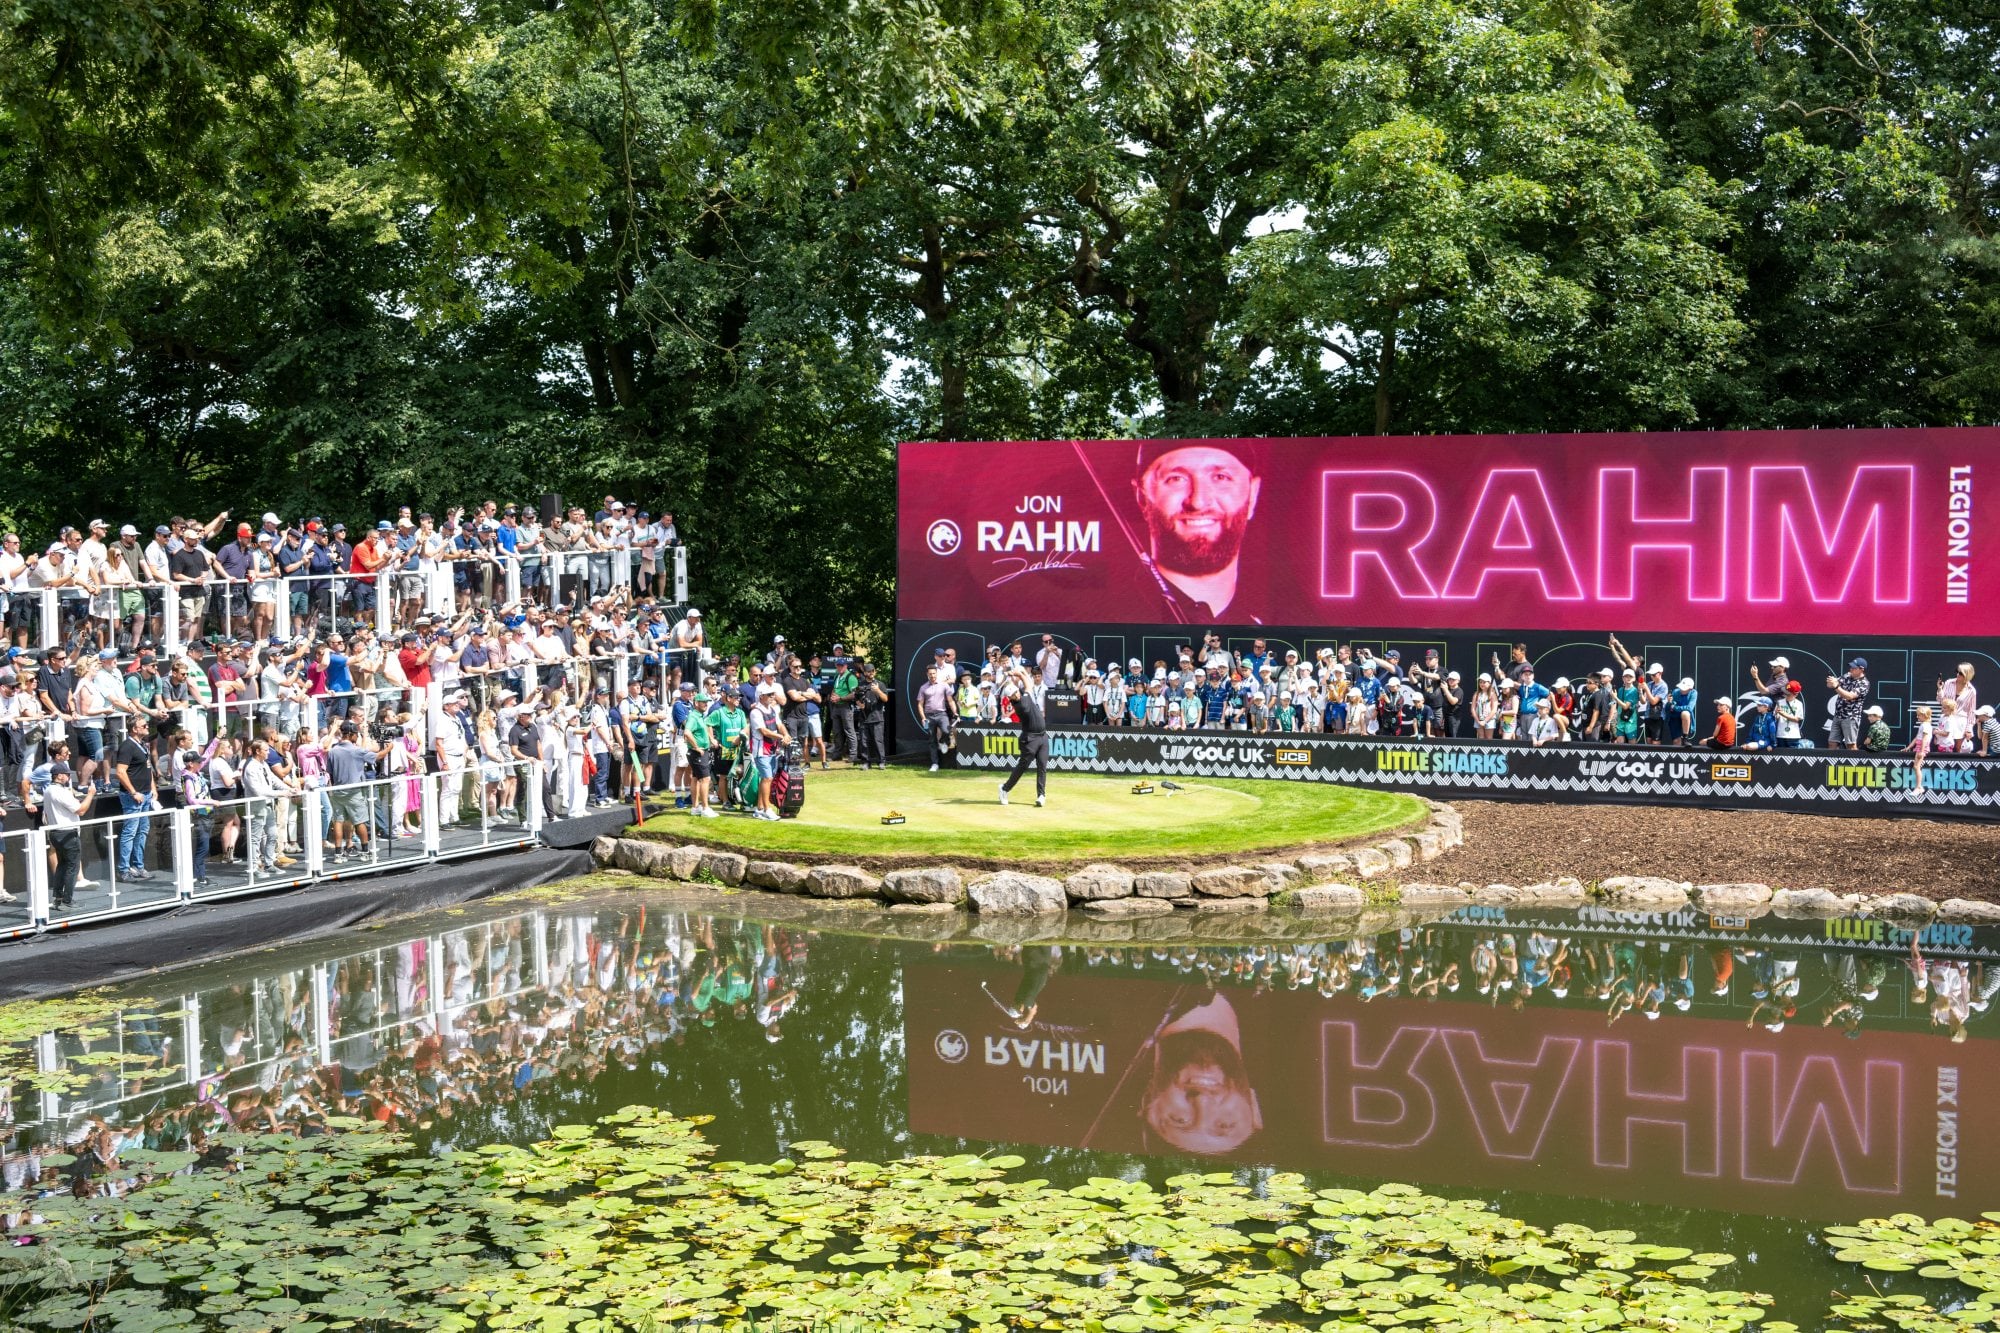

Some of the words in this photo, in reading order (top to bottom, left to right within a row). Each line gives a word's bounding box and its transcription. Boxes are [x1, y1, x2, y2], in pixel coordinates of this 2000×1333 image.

[1015, 495, 1061, 514] JON
[1947, 464, 1972, 558] LEGION
[977, 520, 1100, 552] RAHM
[1319, 464, 1916, 605] RAHM
[1946, 561, 1969, 604] XIII
[983, 735, 1021, 755] LITTL
[1048, 737, 1099, 759] ARKS
[1193, 746, 1235, 763] GOLF
[1239, 747, 1266, 764] UK
[1279, 752, 1310, 763] JCB
[1376, 750, 1430, 772] LITTLE
[1432, 751, 1509, 775] SHARKS
[1615, 761, 1665, 778] GOLF
[1669, 762, 1699, 780] UK
[1714, 767, 1749, 779] JCB
[1827, 765, 1887, 788] LITTLE
[1890, 767, 1978, 792] SHARKS
